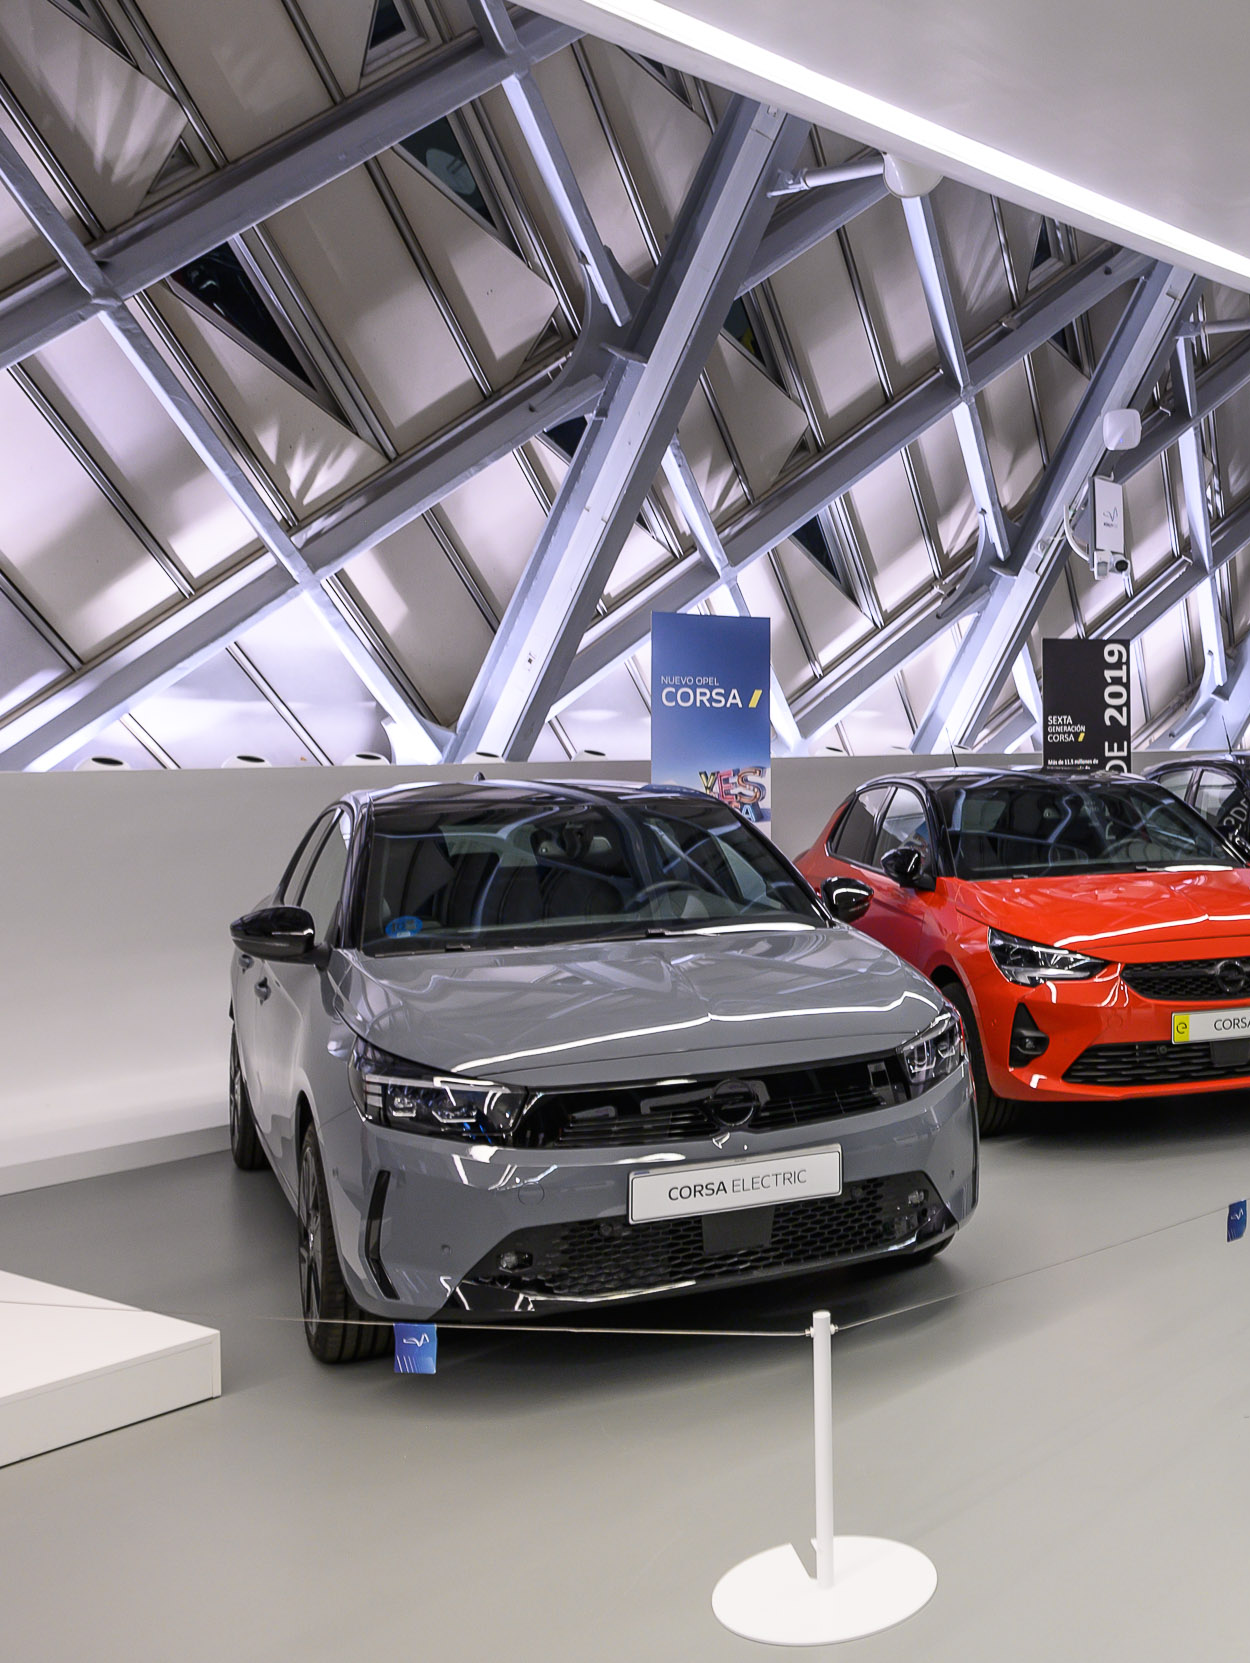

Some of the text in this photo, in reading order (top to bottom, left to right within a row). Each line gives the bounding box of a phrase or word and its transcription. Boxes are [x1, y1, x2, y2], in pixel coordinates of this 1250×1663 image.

[661, 675, 719, 687] NUEVO OPEL
[1103, 643, 1128, 727] 2019
[661, 687, 743, 709] CORSA
[1047, 715, 1073, 725] SEXTA
[1047, 724, 1086, 733] GENERACIÓN
[1047, 733, 1075, 743] CORSA
[698, 766, 766, 804] YES
[668, 1169, 808, 1201] CORSA ELECTRIC
